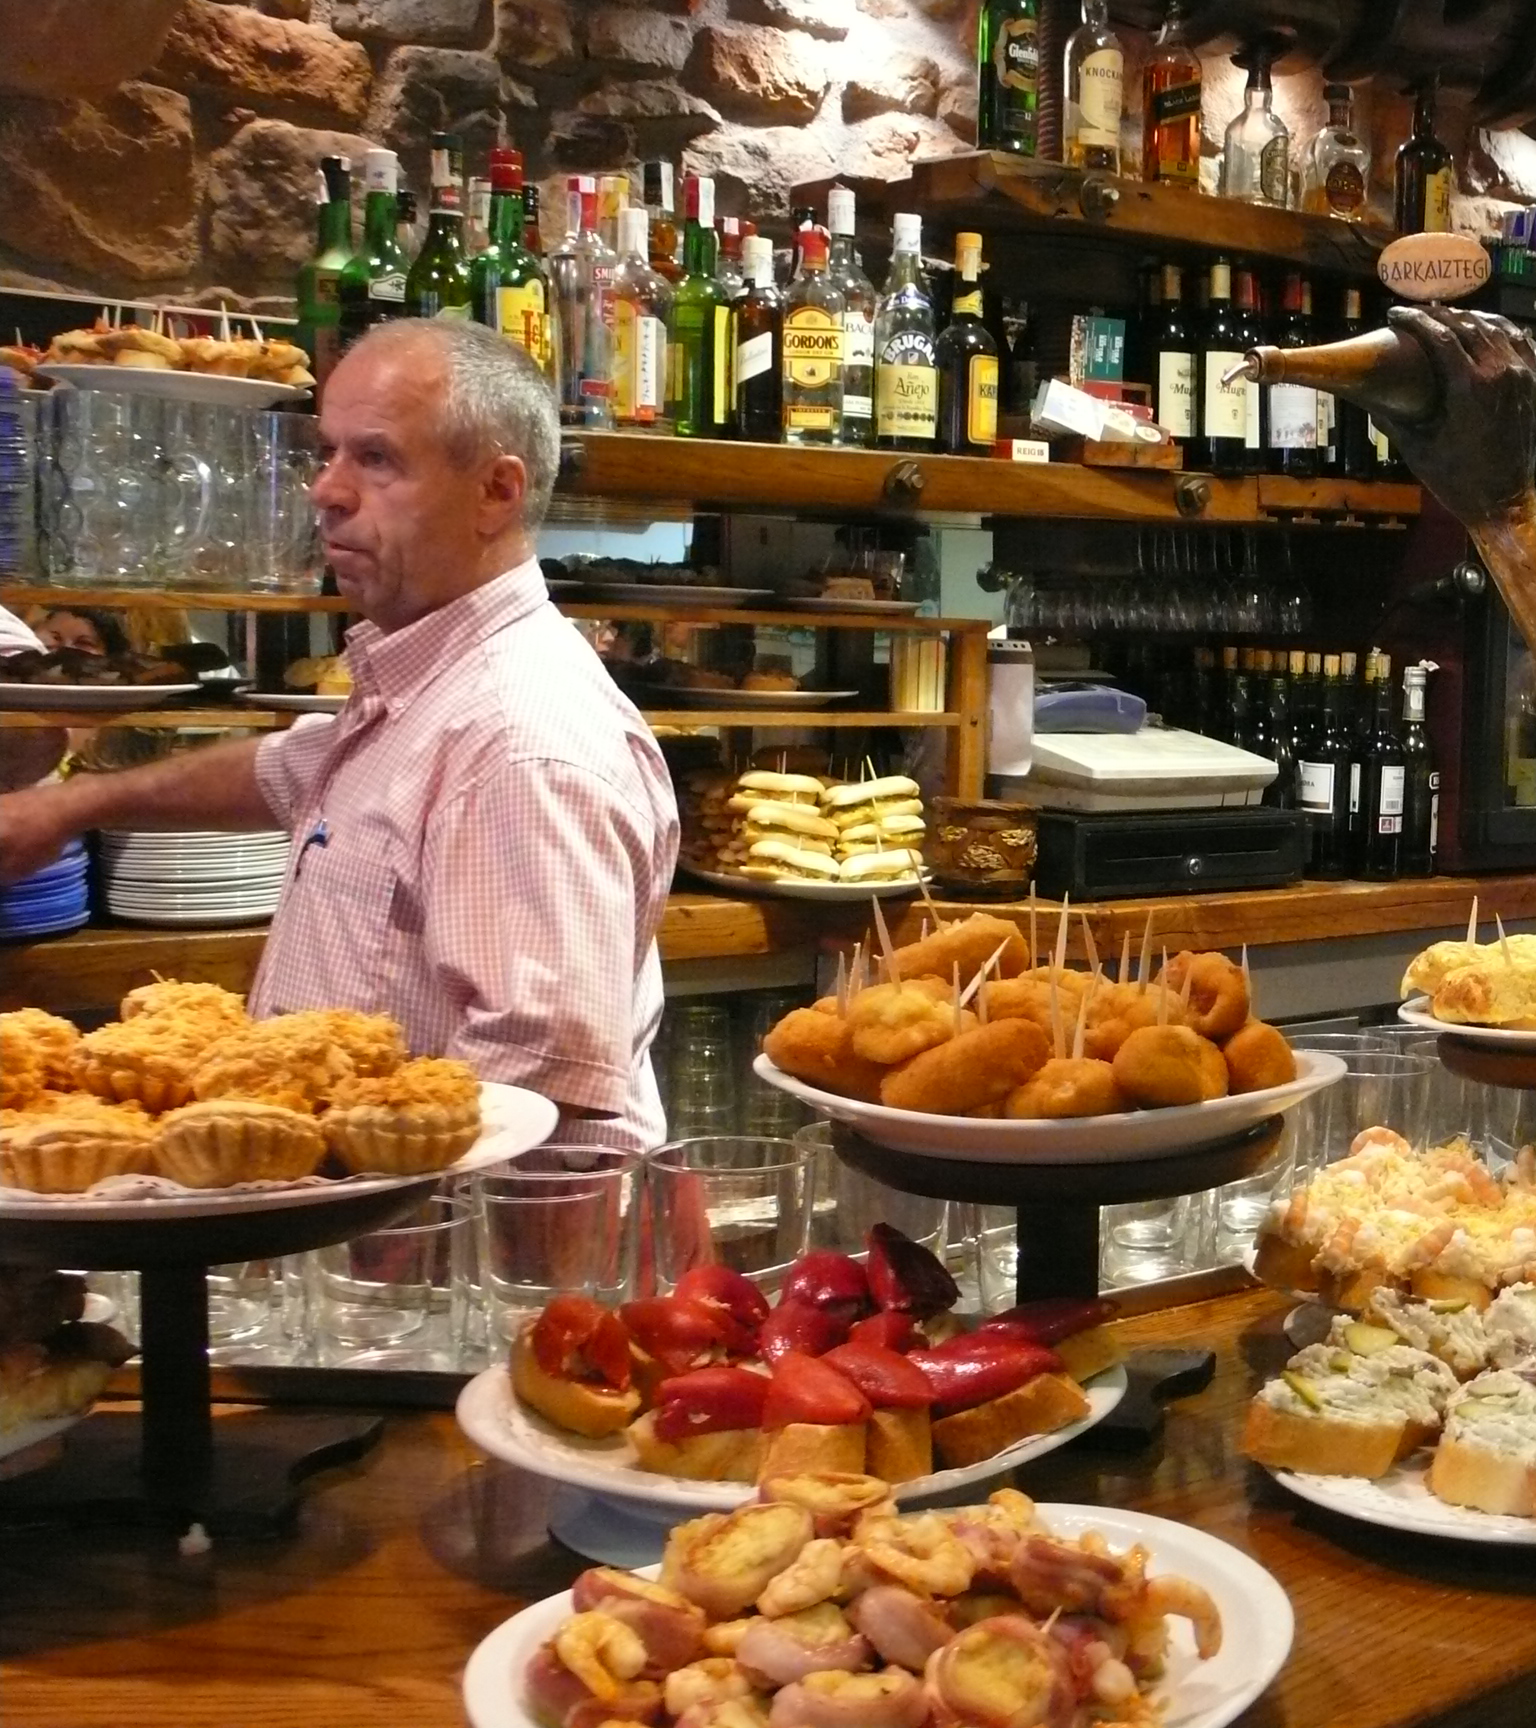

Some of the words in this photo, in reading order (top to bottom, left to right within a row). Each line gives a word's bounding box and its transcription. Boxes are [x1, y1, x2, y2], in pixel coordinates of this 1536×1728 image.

[1380, 256, 1490, 285] BARKAIZTEGI
[784, 332, 840, 350] GORDON'S
[893, 377, 930, 400] Añejo
